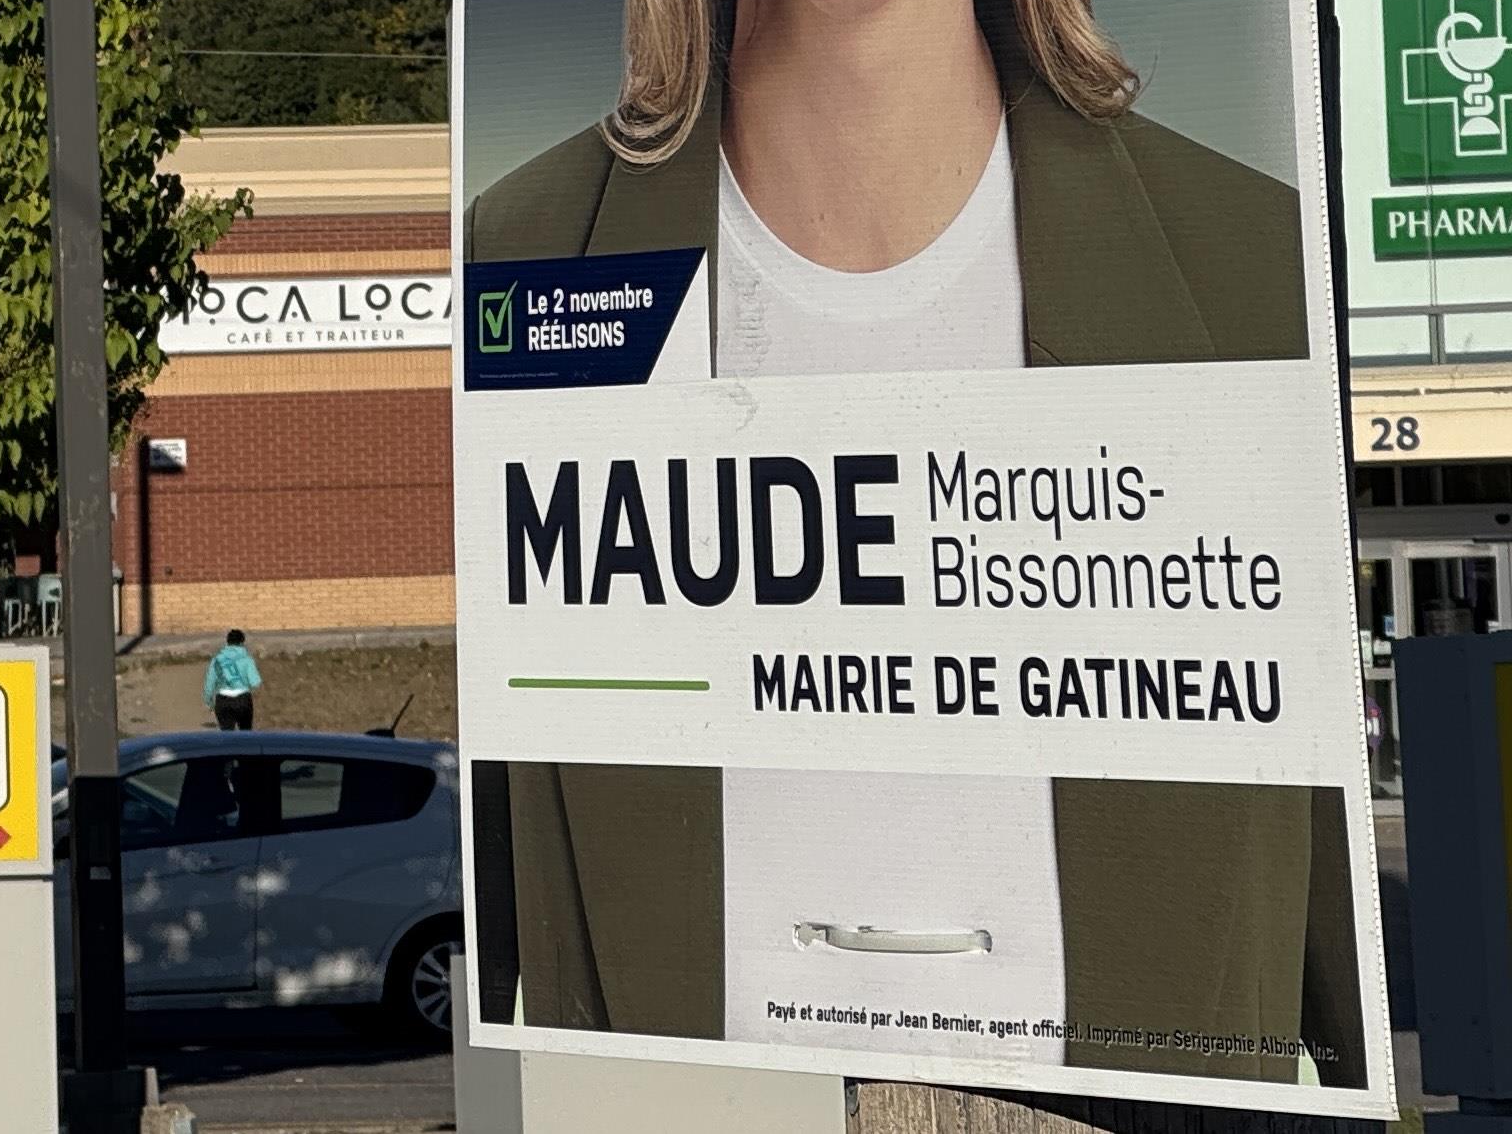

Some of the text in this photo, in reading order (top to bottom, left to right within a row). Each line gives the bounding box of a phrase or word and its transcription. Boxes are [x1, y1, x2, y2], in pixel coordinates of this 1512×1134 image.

[1389, 206, 1512, 239] PHARM
[180, 282, 452, 325] OCA LOC
[527, 282, 654, 315] Le 2 novembre
[286, 329, 305, 343] ET
[316, 328, 406, 343] TRAITEUR
[528, 318, 625, 352] RÉÉLISONS
[1371, 416, 1420, 452] 28
[505, 445, 1165, 608] MAUDE Marquis-
[931, 534, 1282, 611] Bissonnette
[752, 654, 1282, 724] MAIRIE DE GATINEAU
[767, 1001, 796, 1024] Payé
[800, 1004, 813, 1021] et
[816, 1006, 867, 1025] autorisé
[871, 1013, 892, 1030] par
[895, 1010, 928, 1030] Jean
[932, 1012, 985, 1036] Bernier,
[989, 1018, 1028, 1040] agent
[1032, 1019, 1083, 1043] officiel.
[1087, 1023, 1143, 1049] Imprimé
[1147, 1032, 1171, 1051] par
[1260, 1035, 1307, 1058] Albion
